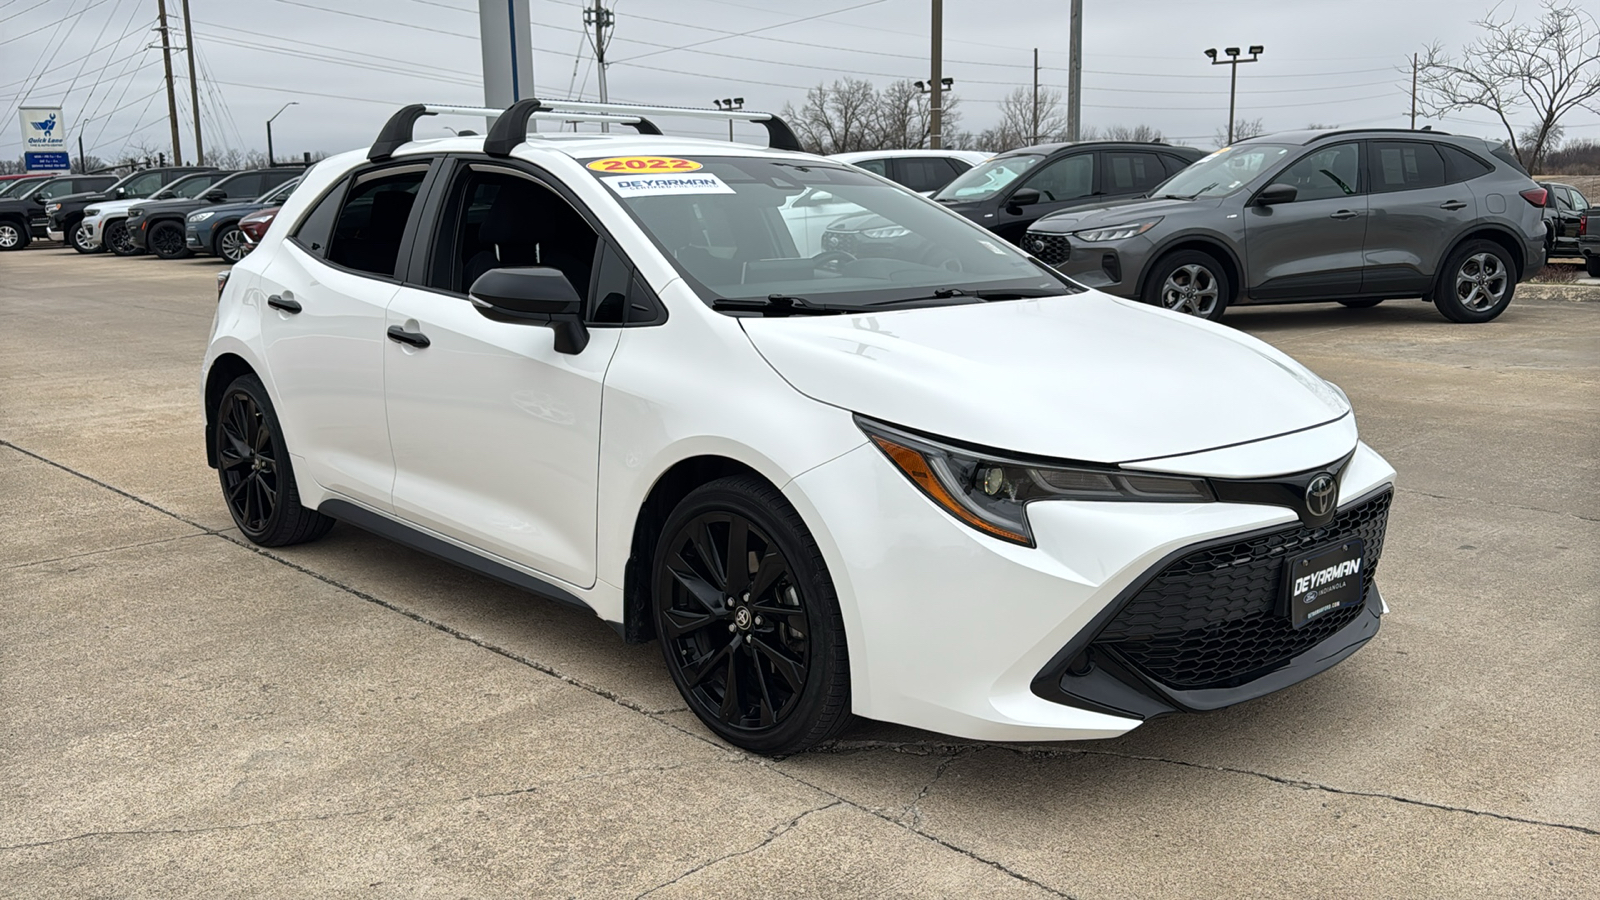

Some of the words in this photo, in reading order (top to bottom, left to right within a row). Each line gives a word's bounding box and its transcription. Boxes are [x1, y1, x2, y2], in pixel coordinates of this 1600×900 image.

[602, 159, 692, 171] 2022
[617, 179, 717, 189] DEYARMAN
[1294, 557, 1361, 597] DEYARMAN
[1318, 581, 1347, 596] INDIANOLA
